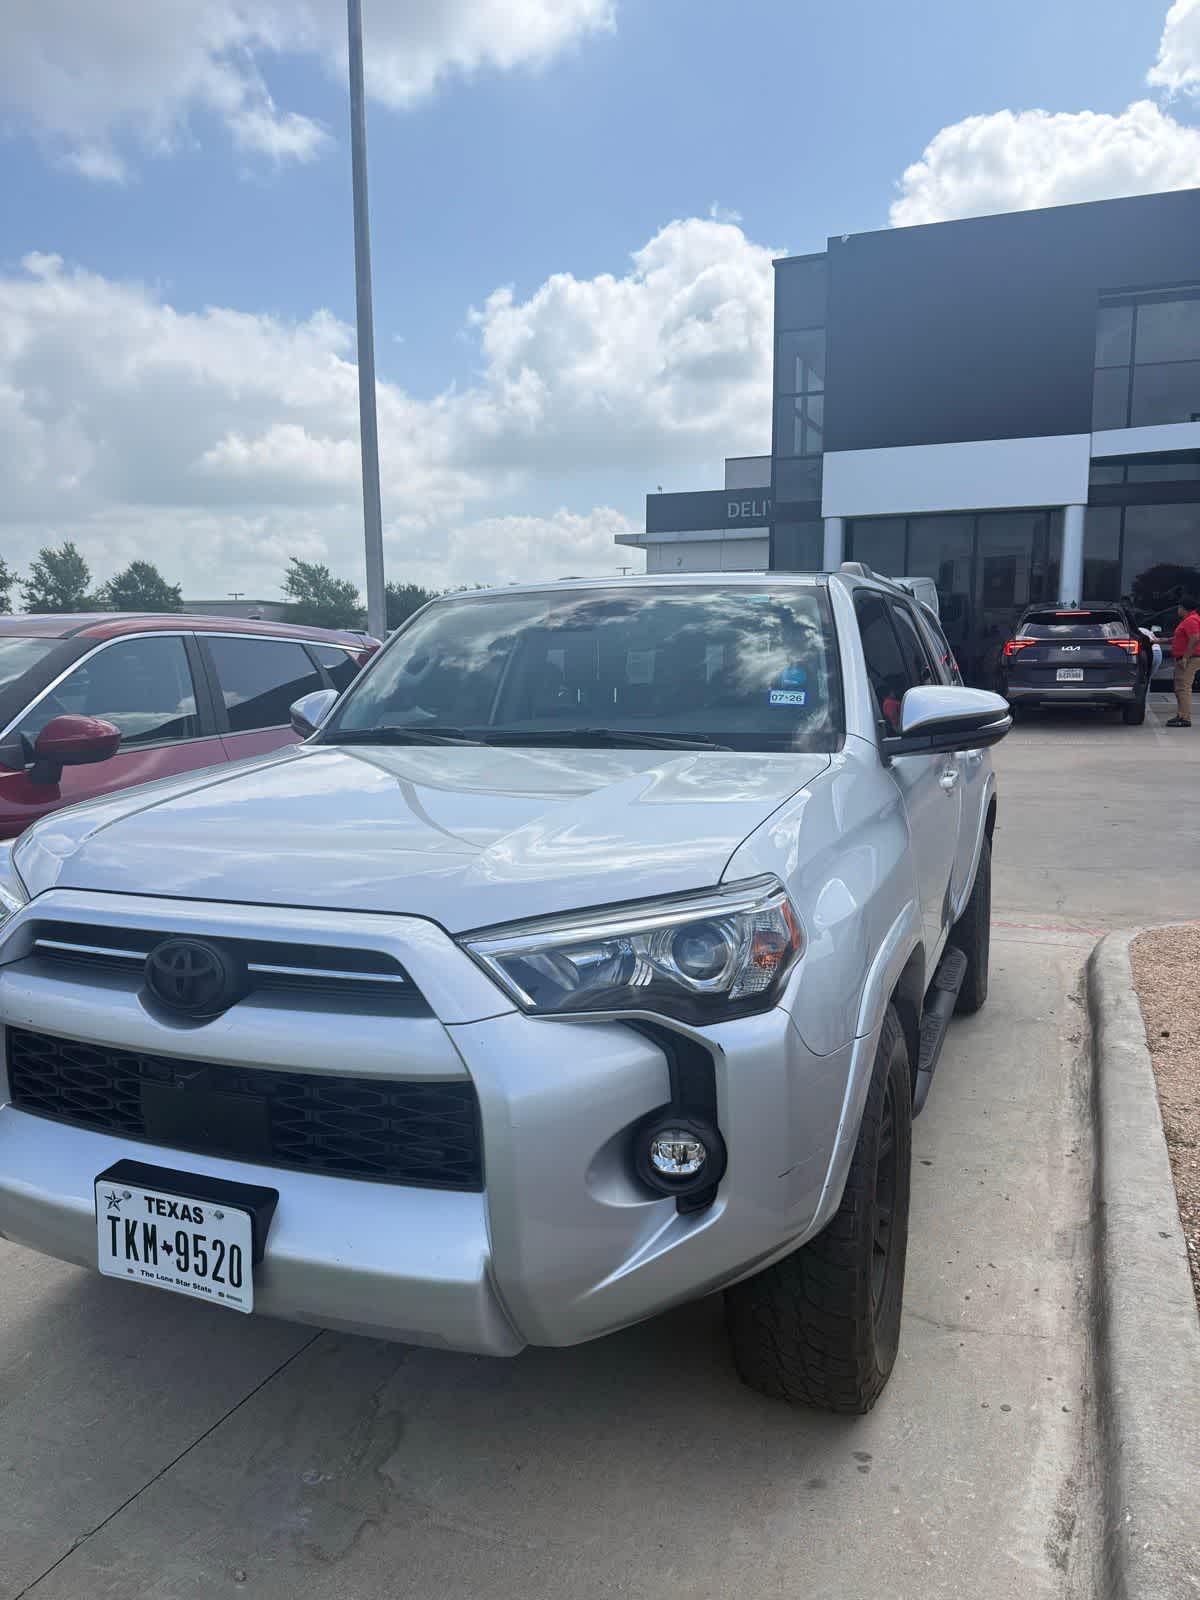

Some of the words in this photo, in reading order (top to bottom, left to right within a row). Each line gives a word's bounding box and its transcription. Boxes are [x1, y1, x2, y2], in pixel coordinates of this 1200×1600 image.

[143, 1195, 204, 1225] TEXAS
[140, 1269, 154, 1279] The
[156, 1273, 174, 1283] Lone
[175, 1278, 191, 1288] Star
[192, 1282, 212, 1294] State
